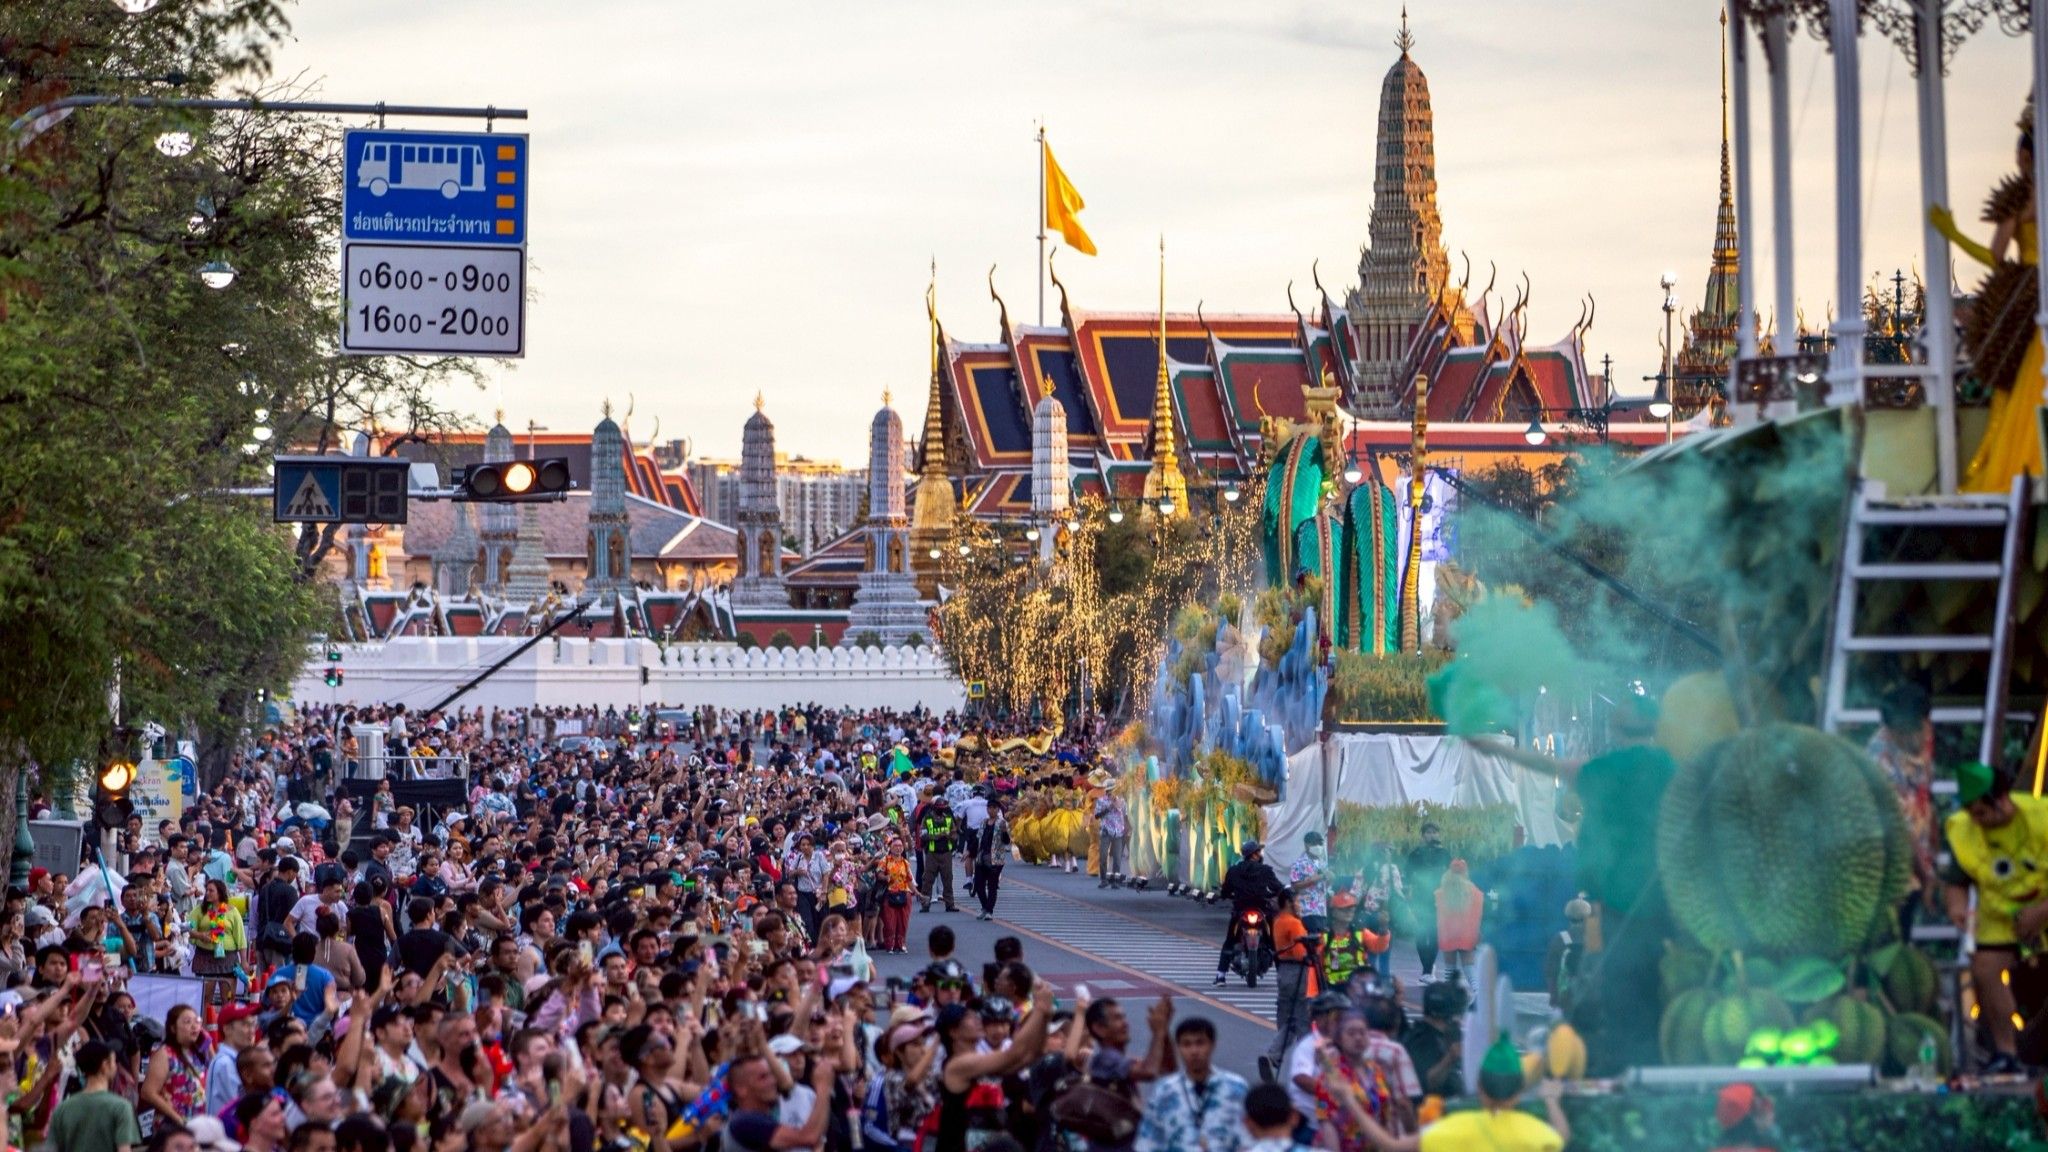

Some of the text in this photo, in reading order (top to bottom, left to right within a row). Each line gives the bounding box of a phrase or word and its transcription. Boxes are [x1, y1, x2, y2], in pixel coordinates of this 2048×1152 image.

[352, 210, 491, 234] ช่องเดินรถประจำทาง
